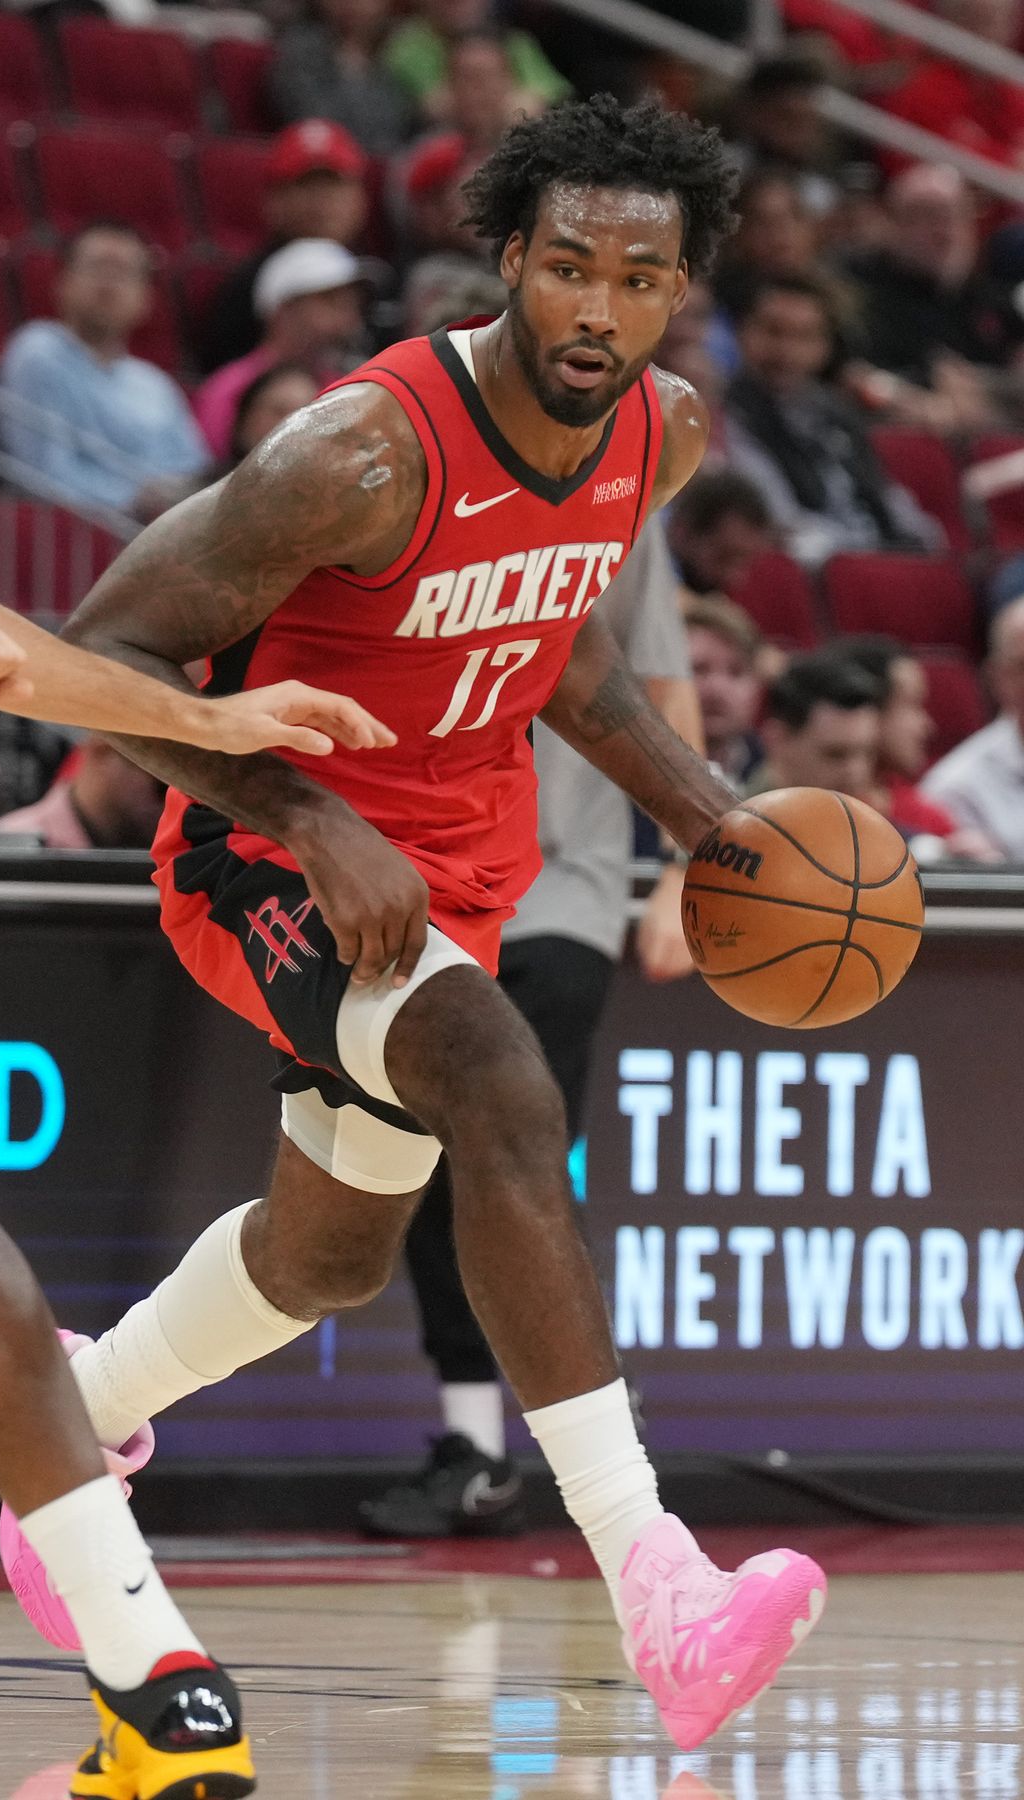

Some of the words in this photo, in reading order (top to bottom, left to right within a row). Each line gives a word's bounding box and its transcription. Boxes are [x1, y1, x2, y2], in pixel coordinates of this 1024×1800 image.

[393, 541, 625, 639] ROCKETS
[427, 638, 542, 739] 17
[693, 825, 764, 880] lson
[618, 1048, 932, 1198] THETA
[614, 1225, 1024, 1351] NETWORK
